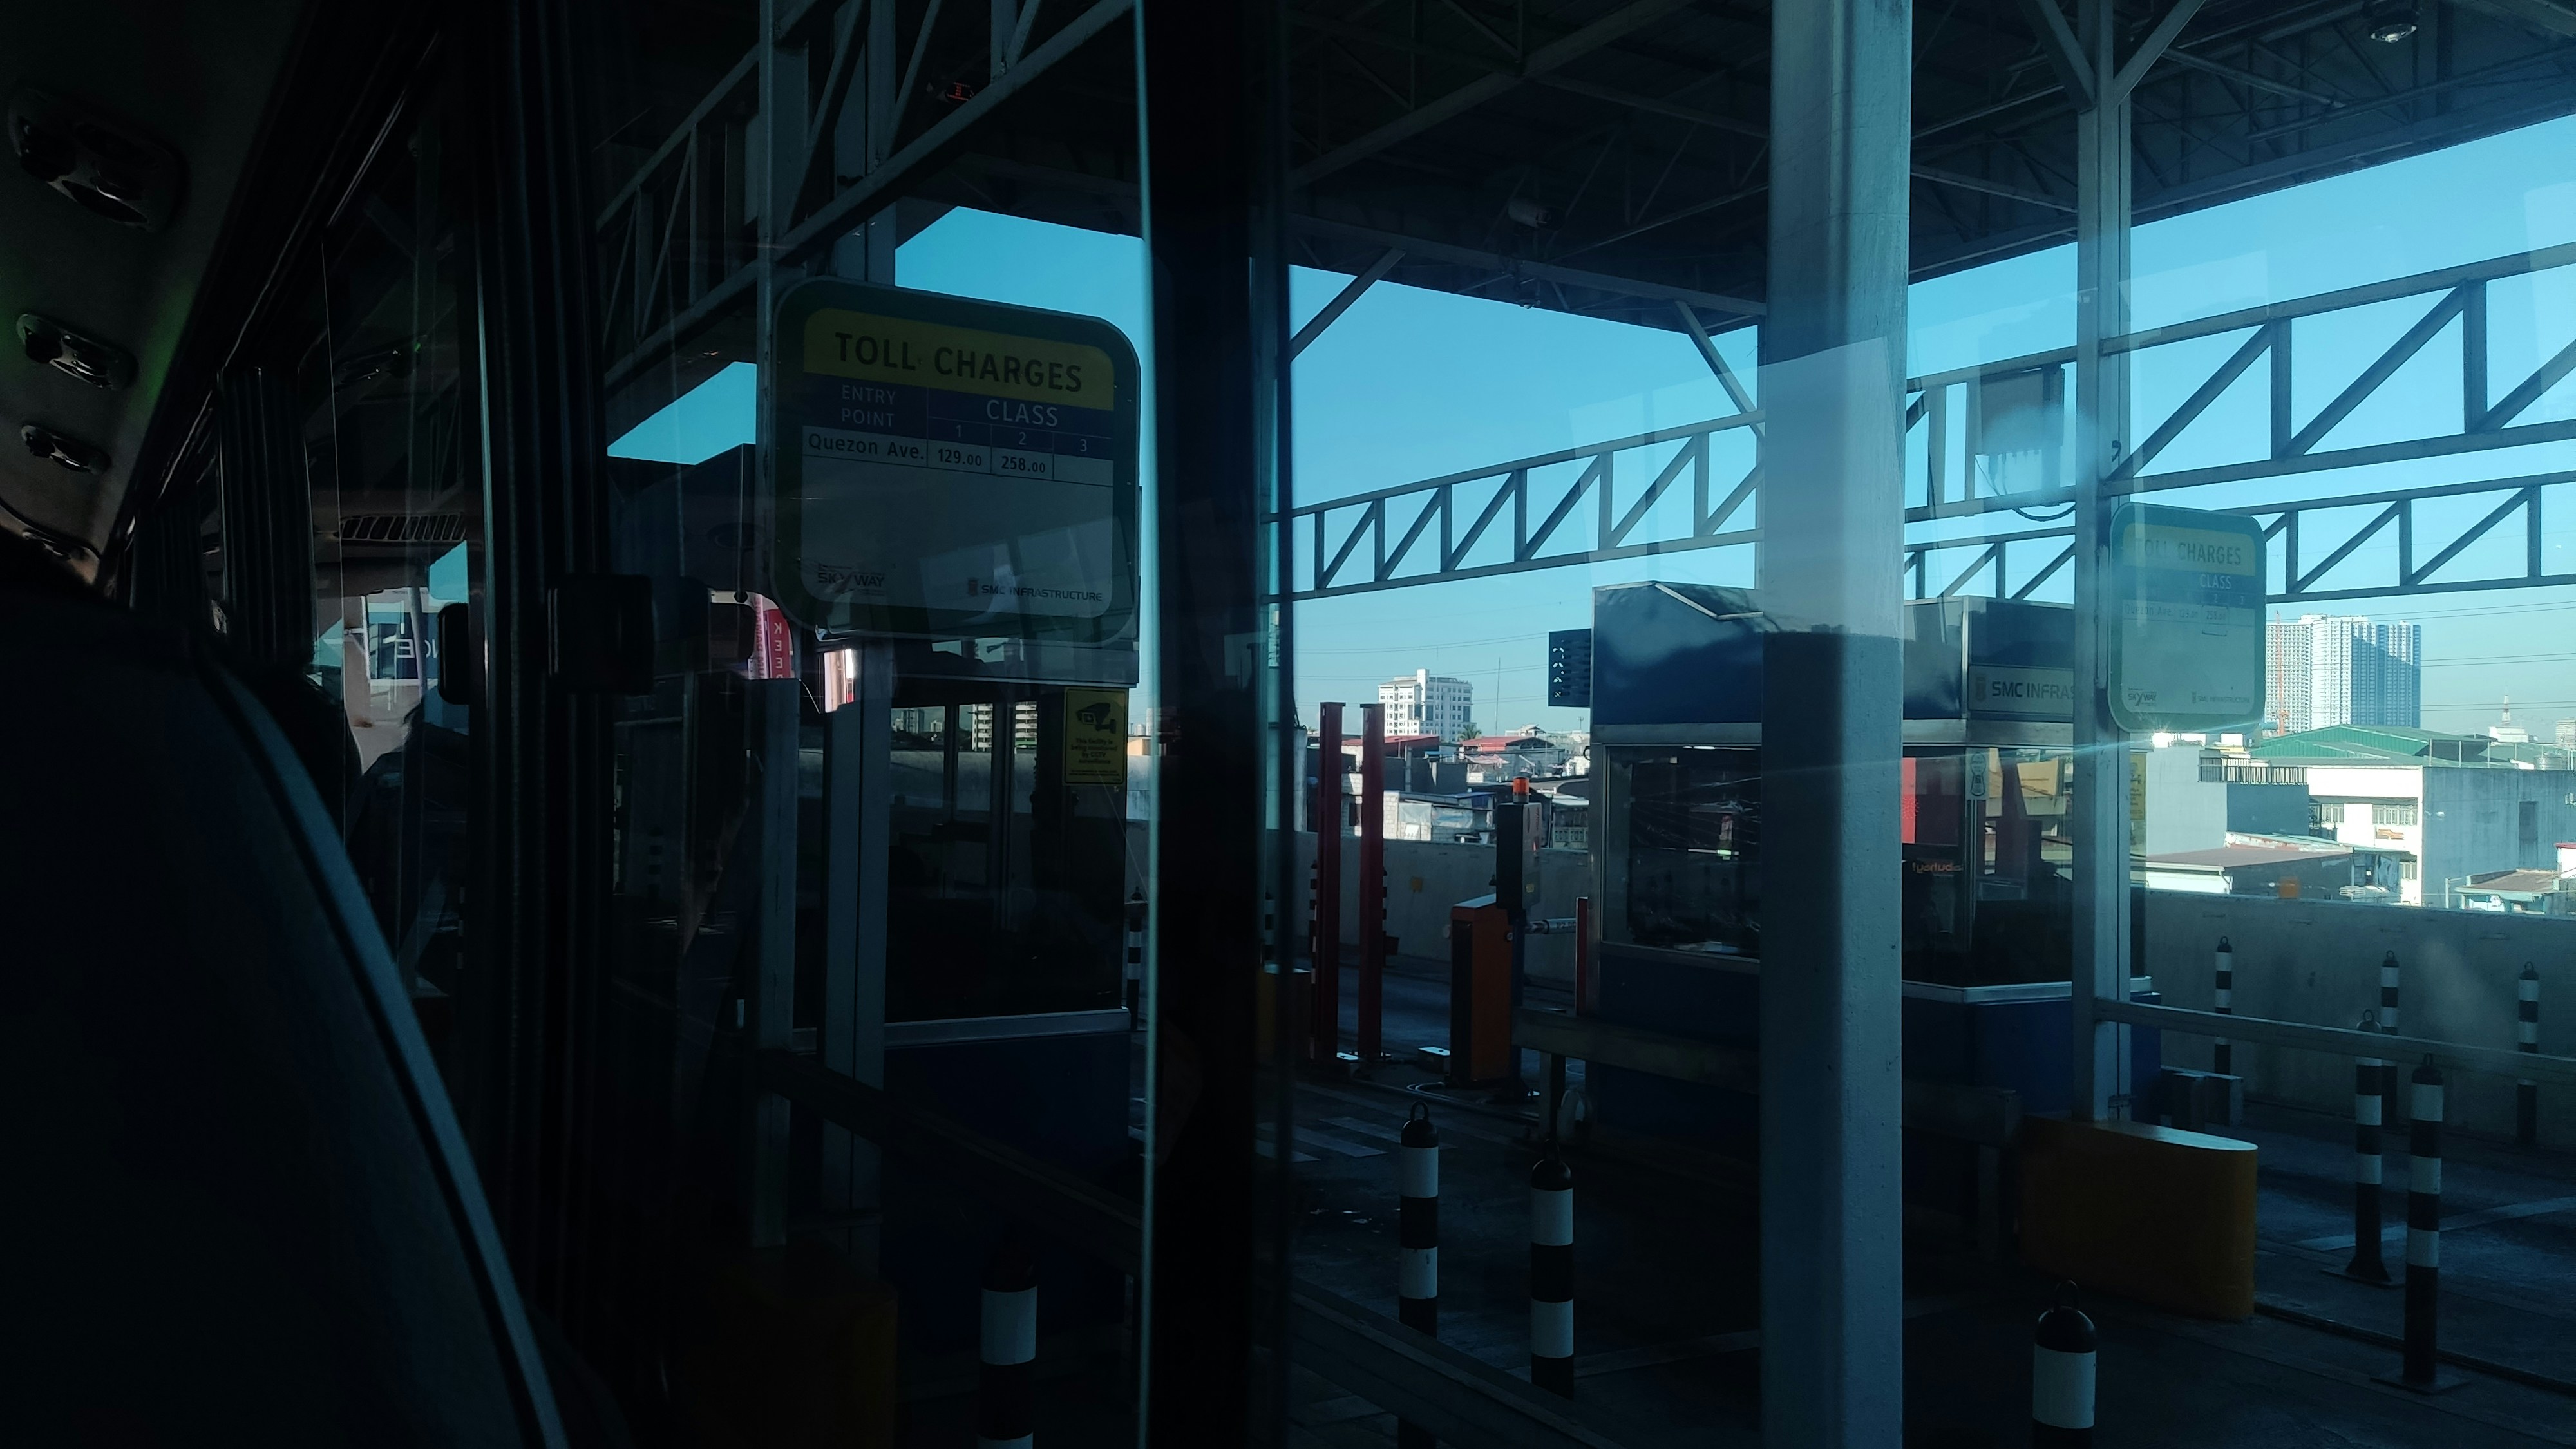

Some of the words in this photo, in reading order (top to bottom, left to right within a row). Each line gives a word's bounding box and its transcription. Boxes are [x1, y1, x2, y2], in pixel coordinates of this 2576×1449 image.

[835, 332, 916, 371] TOLL
[934, 346, 1082, 393] CHARGES
[842, 384, 896, 405] ENTRY
[841, 408, 895, 428] POINT
[986, 399, 1059, 428] CLASS
[808, 433, 878, 455] Quezon
[887, 442, 925, 460] Ave.
[956, 424, 962, 438] 1
[1018, 431, 1027, 446] 2
[1079, 439, 1088, 453] 3
[938, 448, 982, 466] 129.00
[1001, 455, 1046, 473] 258.00
[2178, 542, 2242, 565] CHARGES
[981, 585, 1005, 595] SMC
[1010, 587, 1103, 601] INFRASTRUCTURE
[2199, 573, 2232, 590] CLASS
[1992, 681, 2023, 697] SMC
